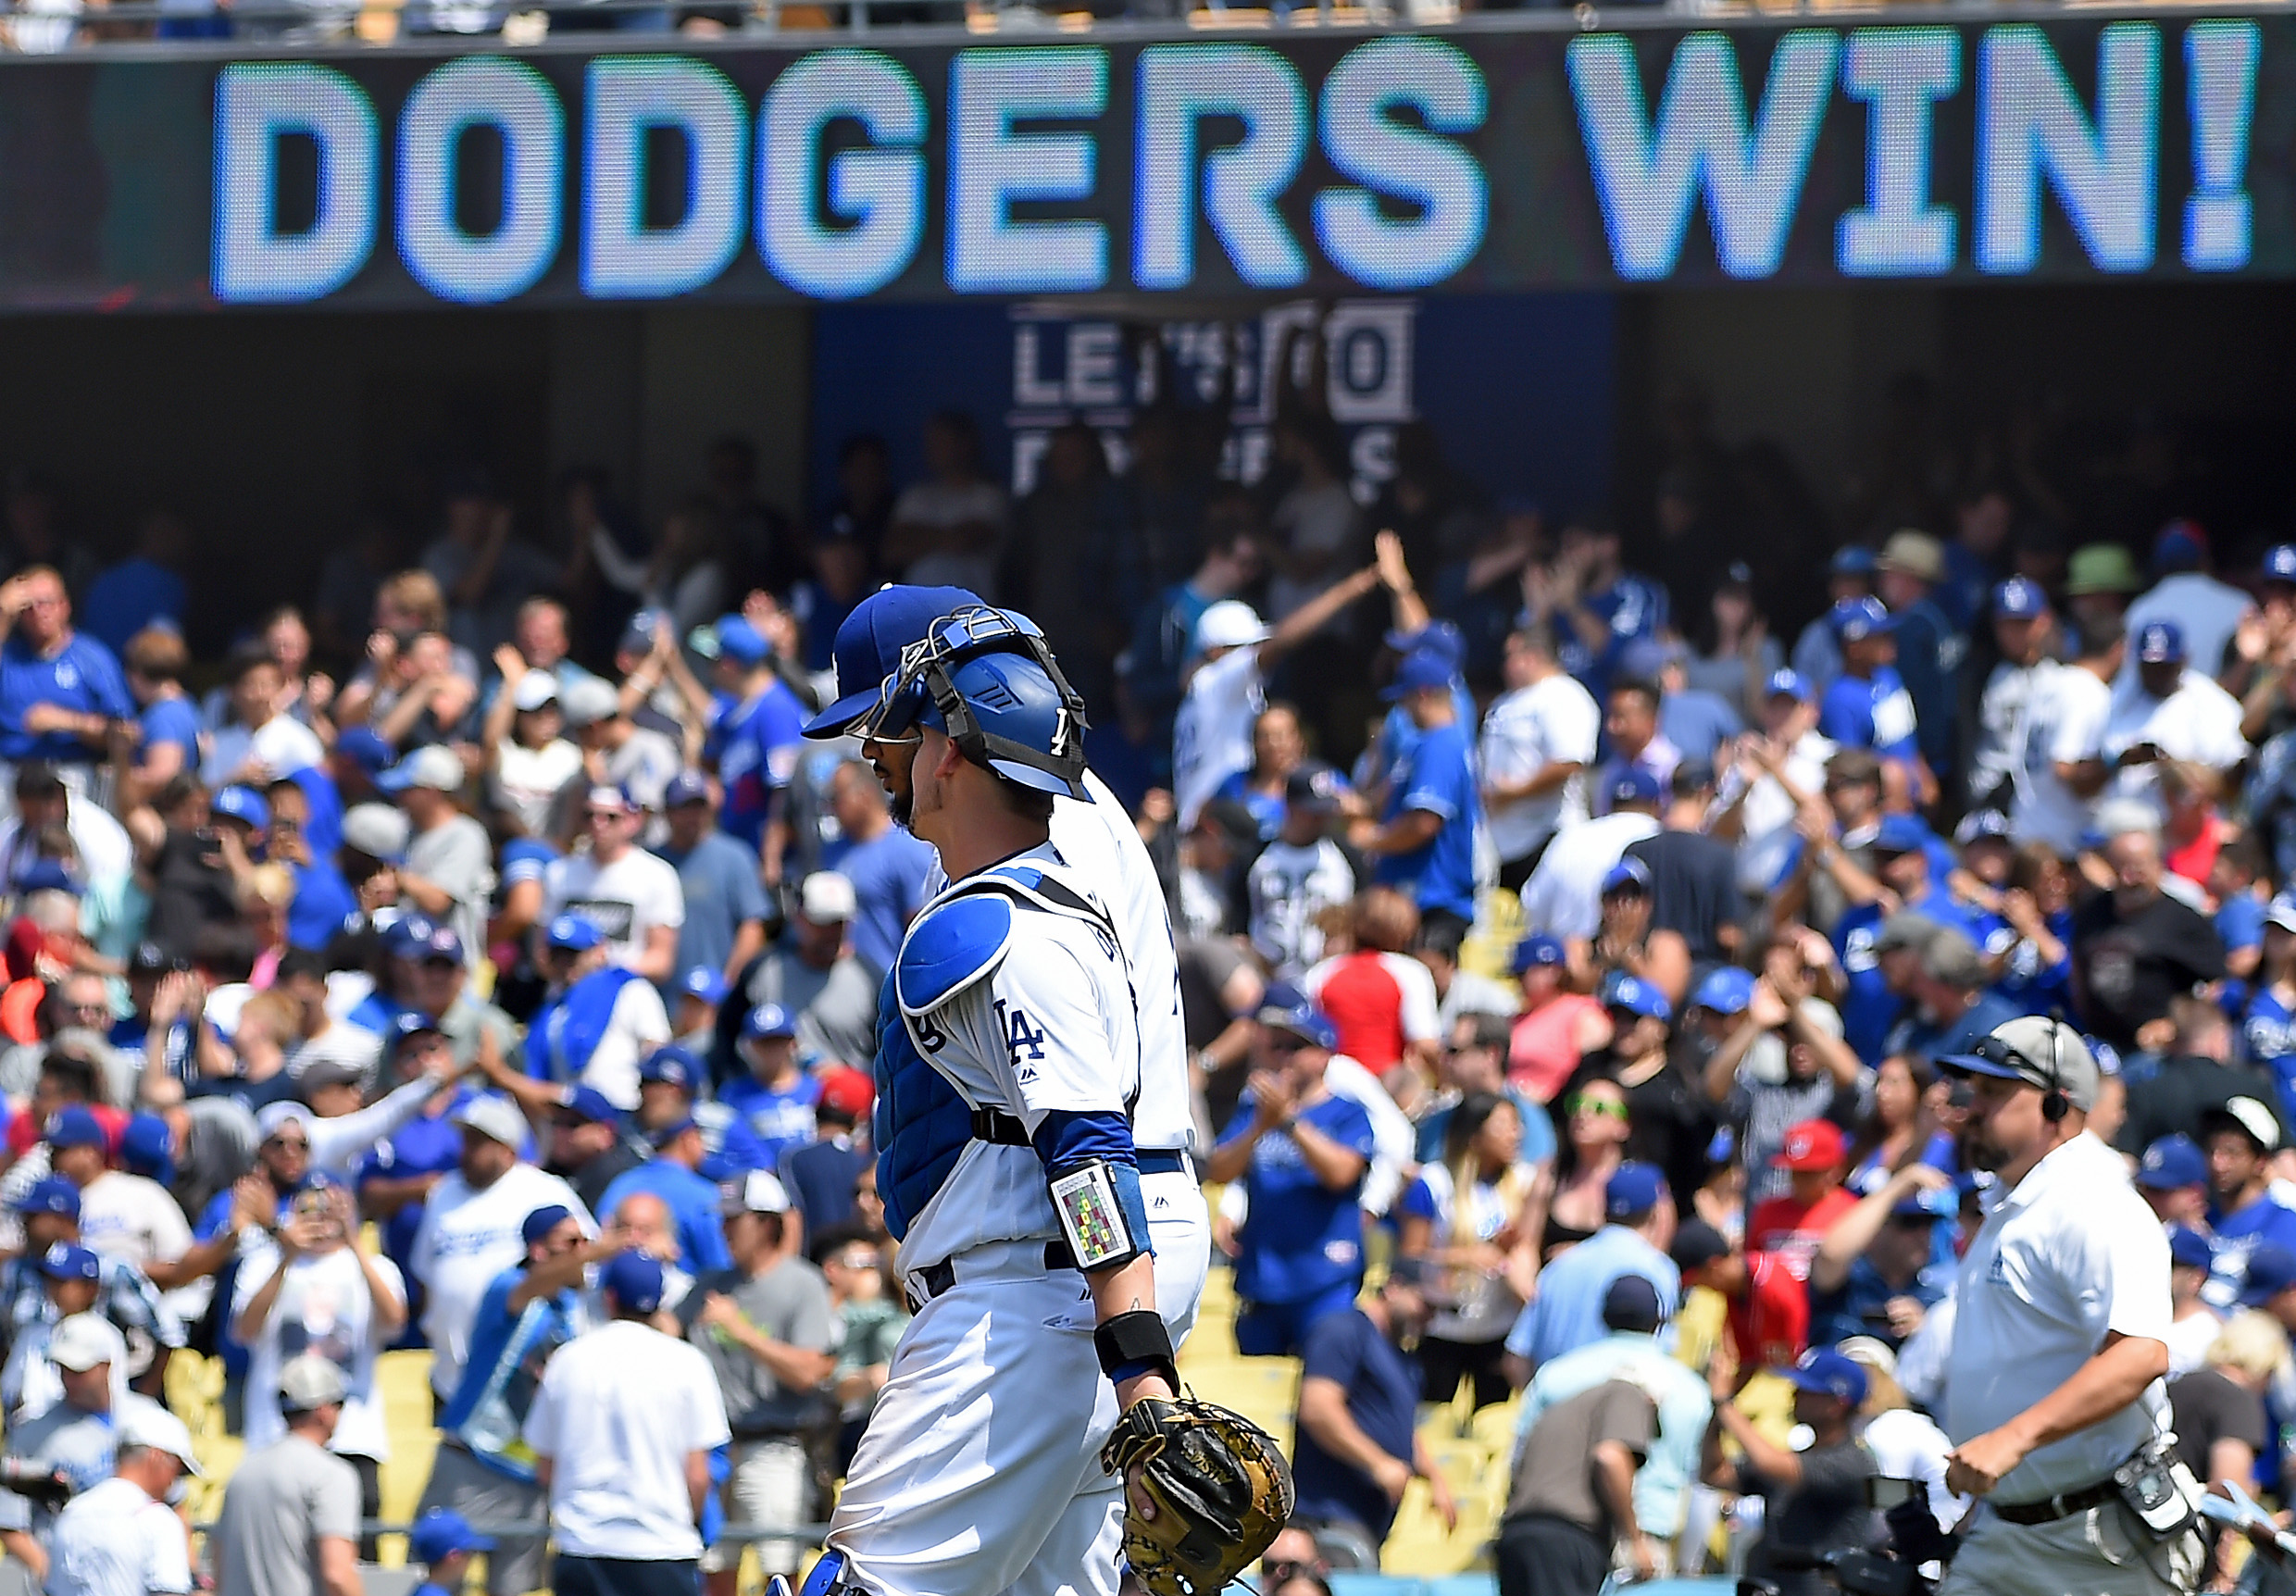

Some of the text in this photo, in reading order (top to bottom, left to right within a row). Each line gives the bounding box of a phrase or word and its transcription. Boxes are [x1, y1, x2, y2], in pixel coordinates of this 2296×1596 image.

[211, 18, 2262, 304] DODGERS WIN!
[993, 998, 1045, 1066] LA
